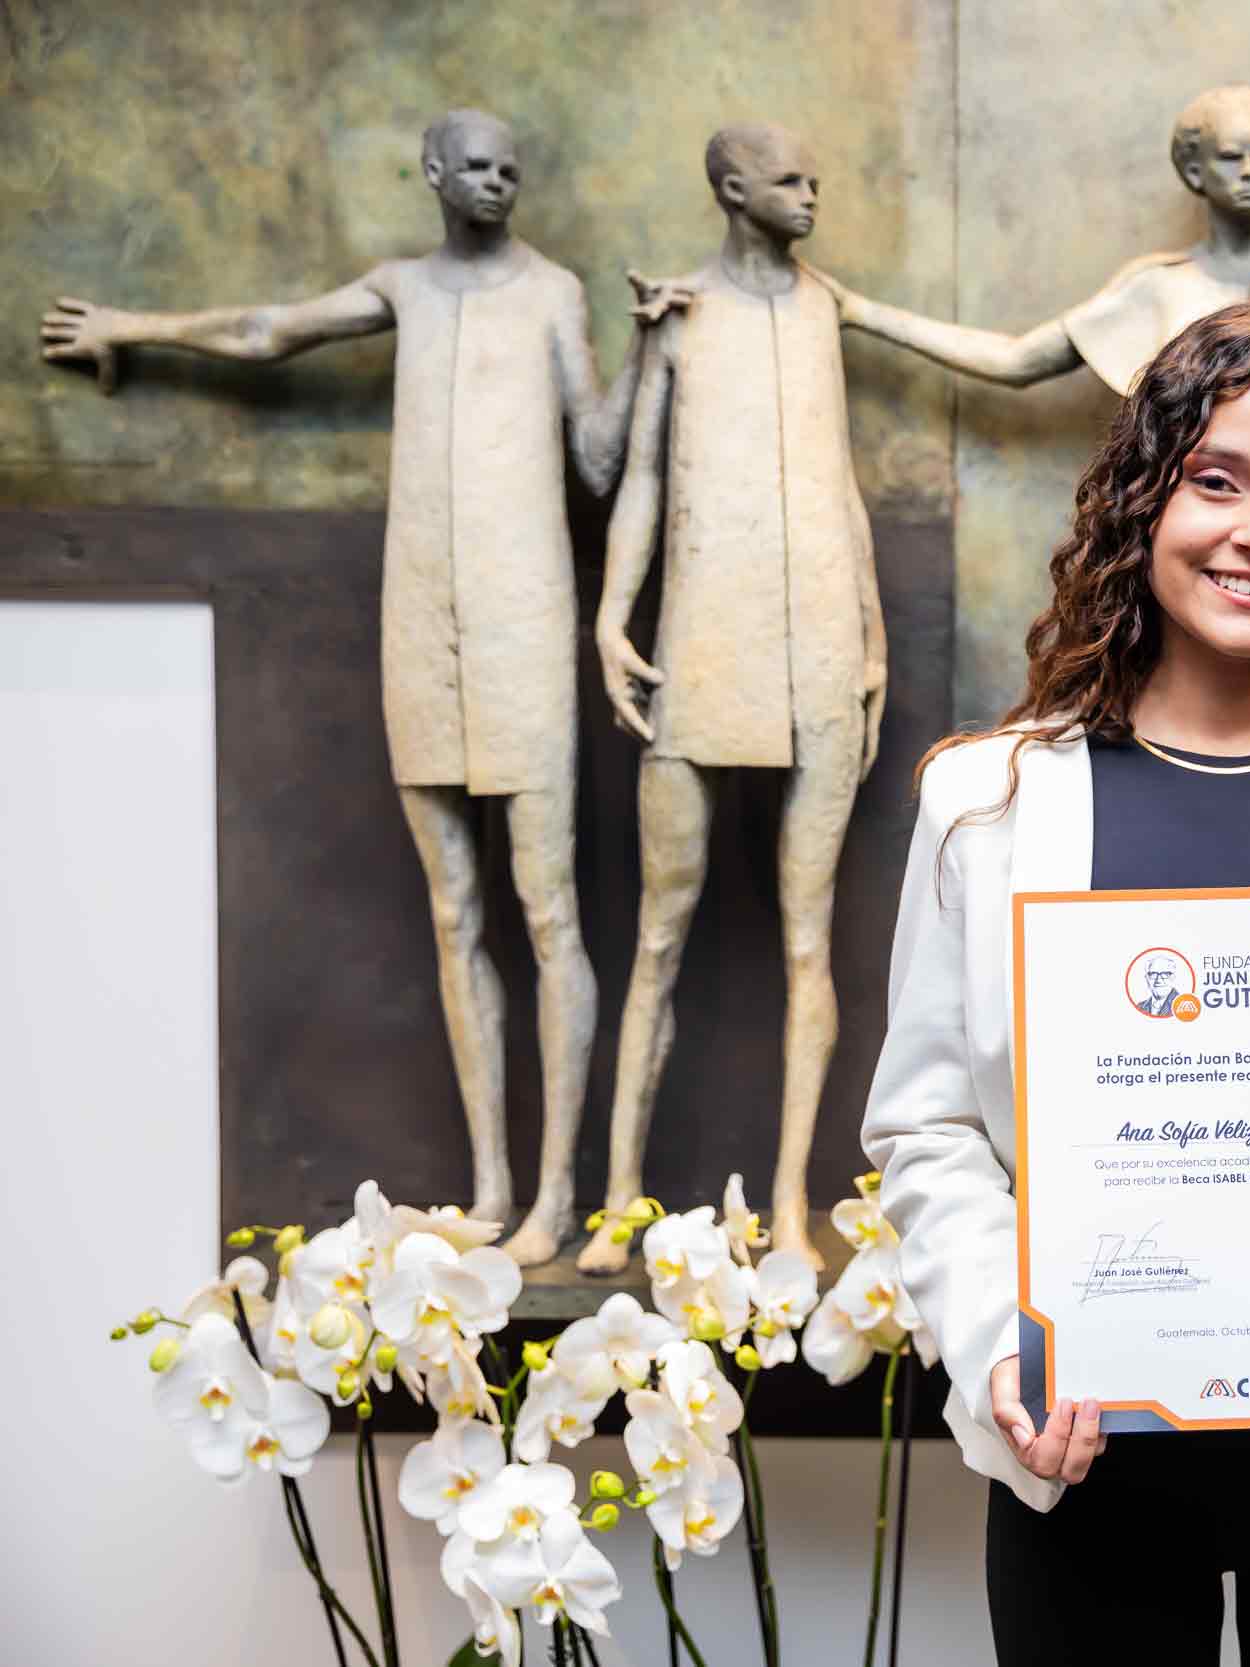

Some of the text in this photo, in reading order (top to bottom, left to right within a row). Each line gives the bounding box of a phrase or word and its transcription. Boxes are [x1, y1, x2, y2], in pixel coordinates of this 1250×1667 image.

[1203, 971, 1248, 985] JUAN
[1097, 1055, 1113, 1067] La
[1117, 1052, 1192, 1067] Fundación
[1196, 1052, 1231, 1065] Juan
[1097, 1072, 1145, 1087] otorga
[1148, 1071, 1161, 1083] el
[1166, 1069, 1228, 1086] presente
[1116, 1121, 1155, 1141] Ana
[1159, 1120, 1209, 1149] Sofía
[1094, 1159, 1119, 1170] Que
[1121, 1161, 1141, 1171] por
[1156, 1157, 1217, 1169] excelencia
[1104, 1178, 1131, 1188] para
[1169, 1175, 1180, 1185] la
[1182, 1175, 1210, 1185] Beca
[1212, 1173, 1247, 1184] ISABEL
[1093, 1267, 1117, 1278] Juan
[1120, 1266, 1143, 1277] José
